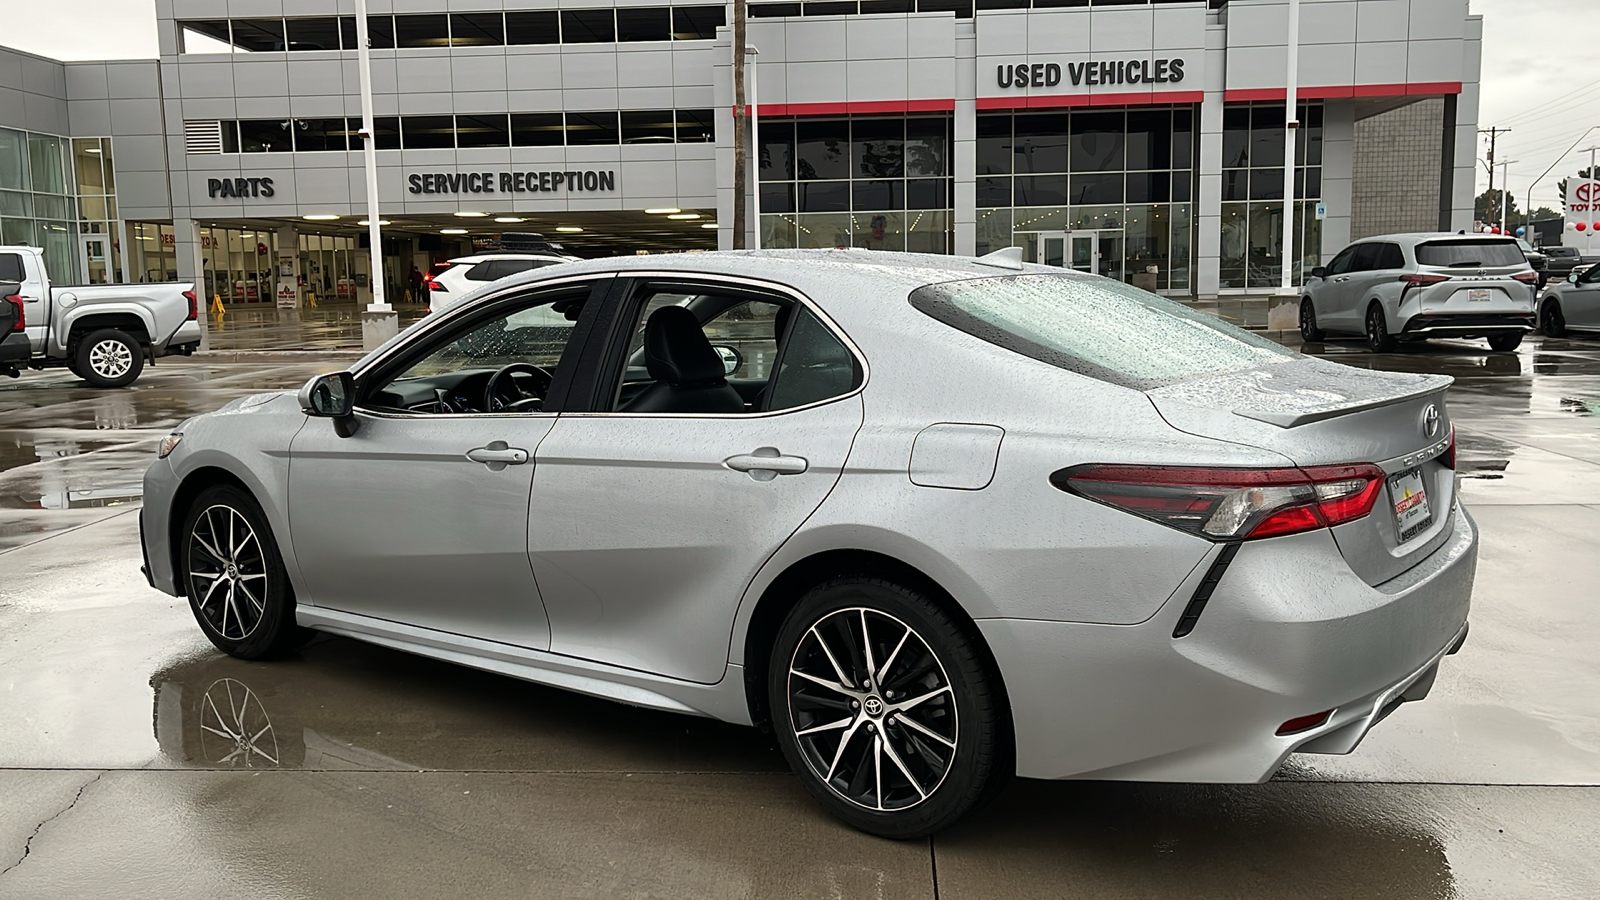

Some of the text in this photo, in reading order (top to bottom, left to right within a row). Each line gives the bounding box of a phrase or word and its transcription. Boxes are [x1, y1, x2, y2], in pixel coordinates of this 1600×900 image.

[997, 59, 1185, 88] USED VEHICLES
[208, 177, 275, 198] PARTS
[408, 170, 615, 194] SERVICE RECEPTION
